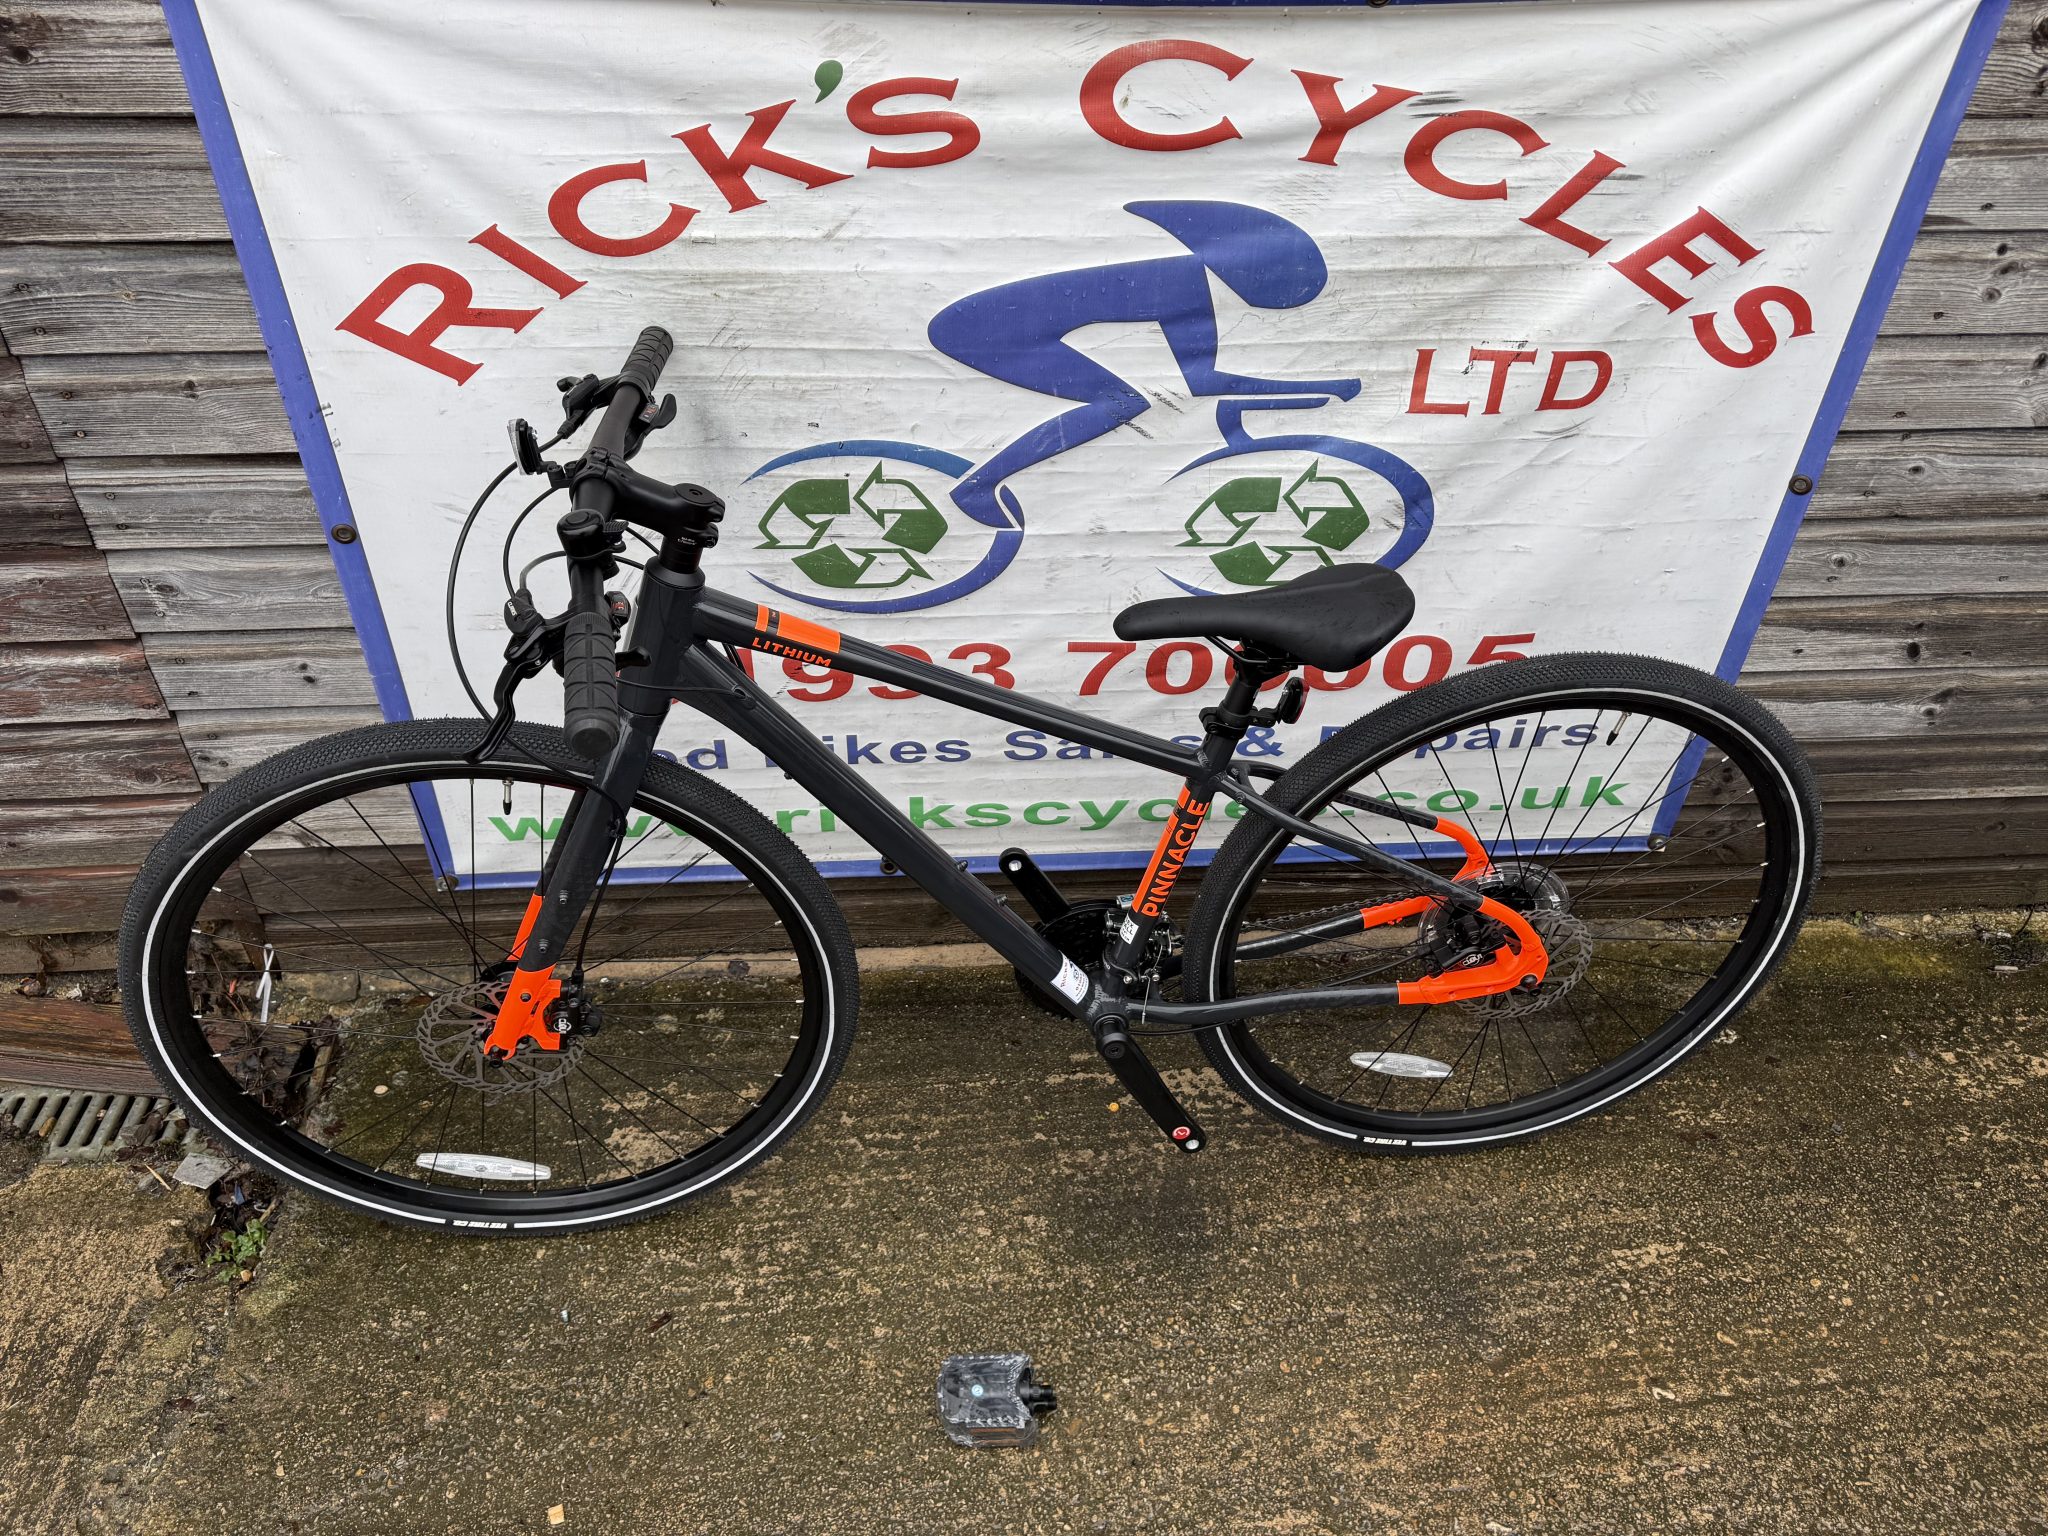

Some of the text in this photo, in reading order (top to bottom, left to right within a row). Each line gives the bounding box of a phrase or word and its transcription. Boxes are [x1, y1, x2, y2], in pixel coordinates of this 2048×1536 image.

[335, 39, 1815, 386] RICK'S CYCLES
[1404, 347, 1614, 418] LTD
[751, 637, 832, 667] LITHIUM
[765, 733, 972, 767] ikes
[1003, 730, 1204, 761] Sas
[1235, 725, 1285, 757] &
[1320, 718, 1599, 759] pairs
[1140, 799, 1210, 917] PINNACLE
